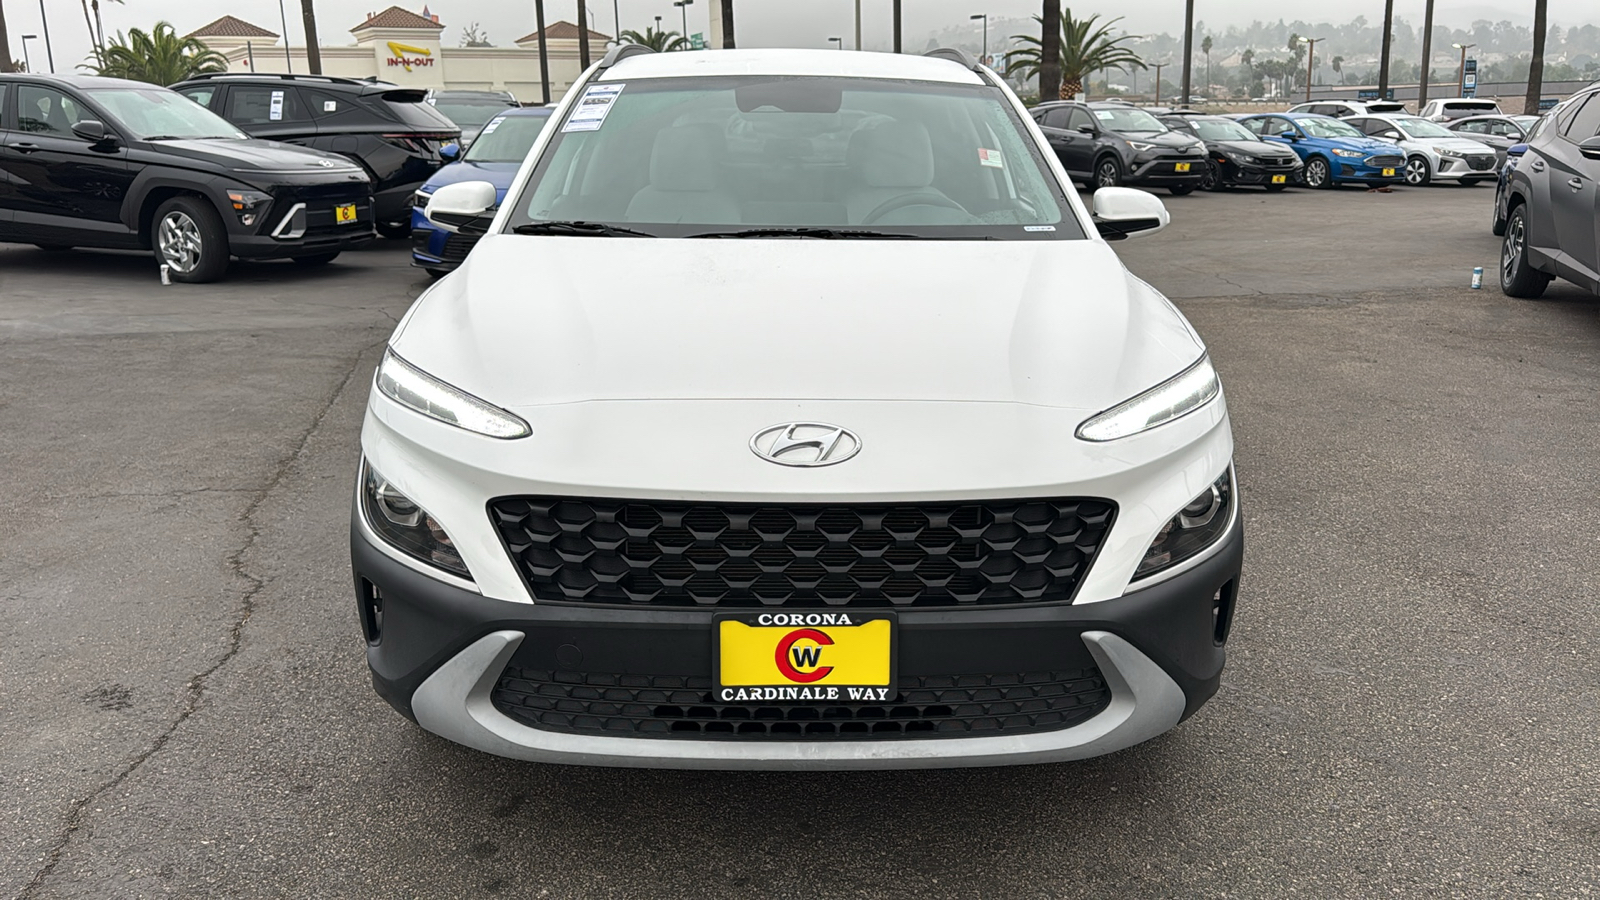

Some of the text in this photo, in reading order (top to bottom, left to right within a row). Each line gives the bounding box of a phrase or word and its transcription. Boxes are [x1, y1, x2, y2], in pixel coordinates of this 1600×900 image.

[387, 58, 434, 66] IN-N-OUT
[758, 613, 852, 626] CORONA
[721, 687, 889, 701] CARDINALE WAY
